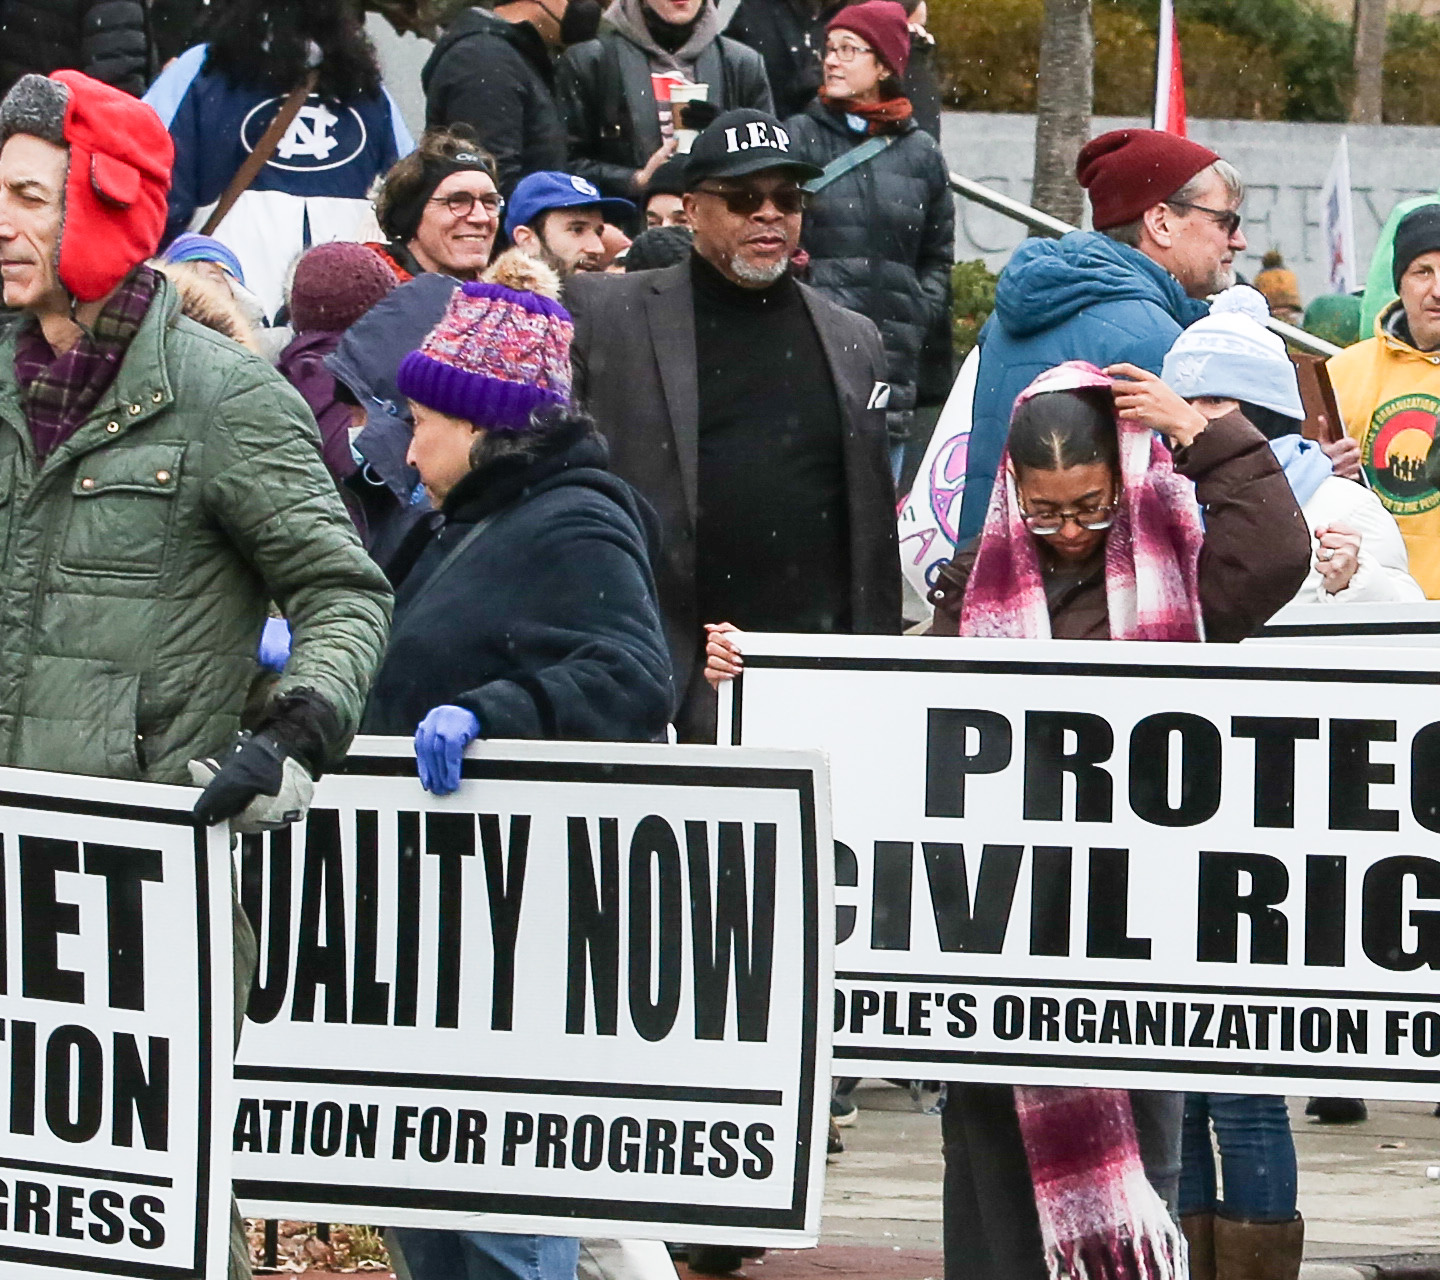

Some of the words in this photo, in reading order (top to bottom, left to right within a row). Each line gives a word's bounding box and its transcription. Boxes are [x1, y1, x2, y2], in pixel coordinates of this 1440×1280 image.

[565, 814, 777, 1044] NOW
[993, 994, 1368, 1054] ORGANIZATION
[392, 1105, 485, 1164] FOR
[501, 1113, 775, 1181] PROGRESS
